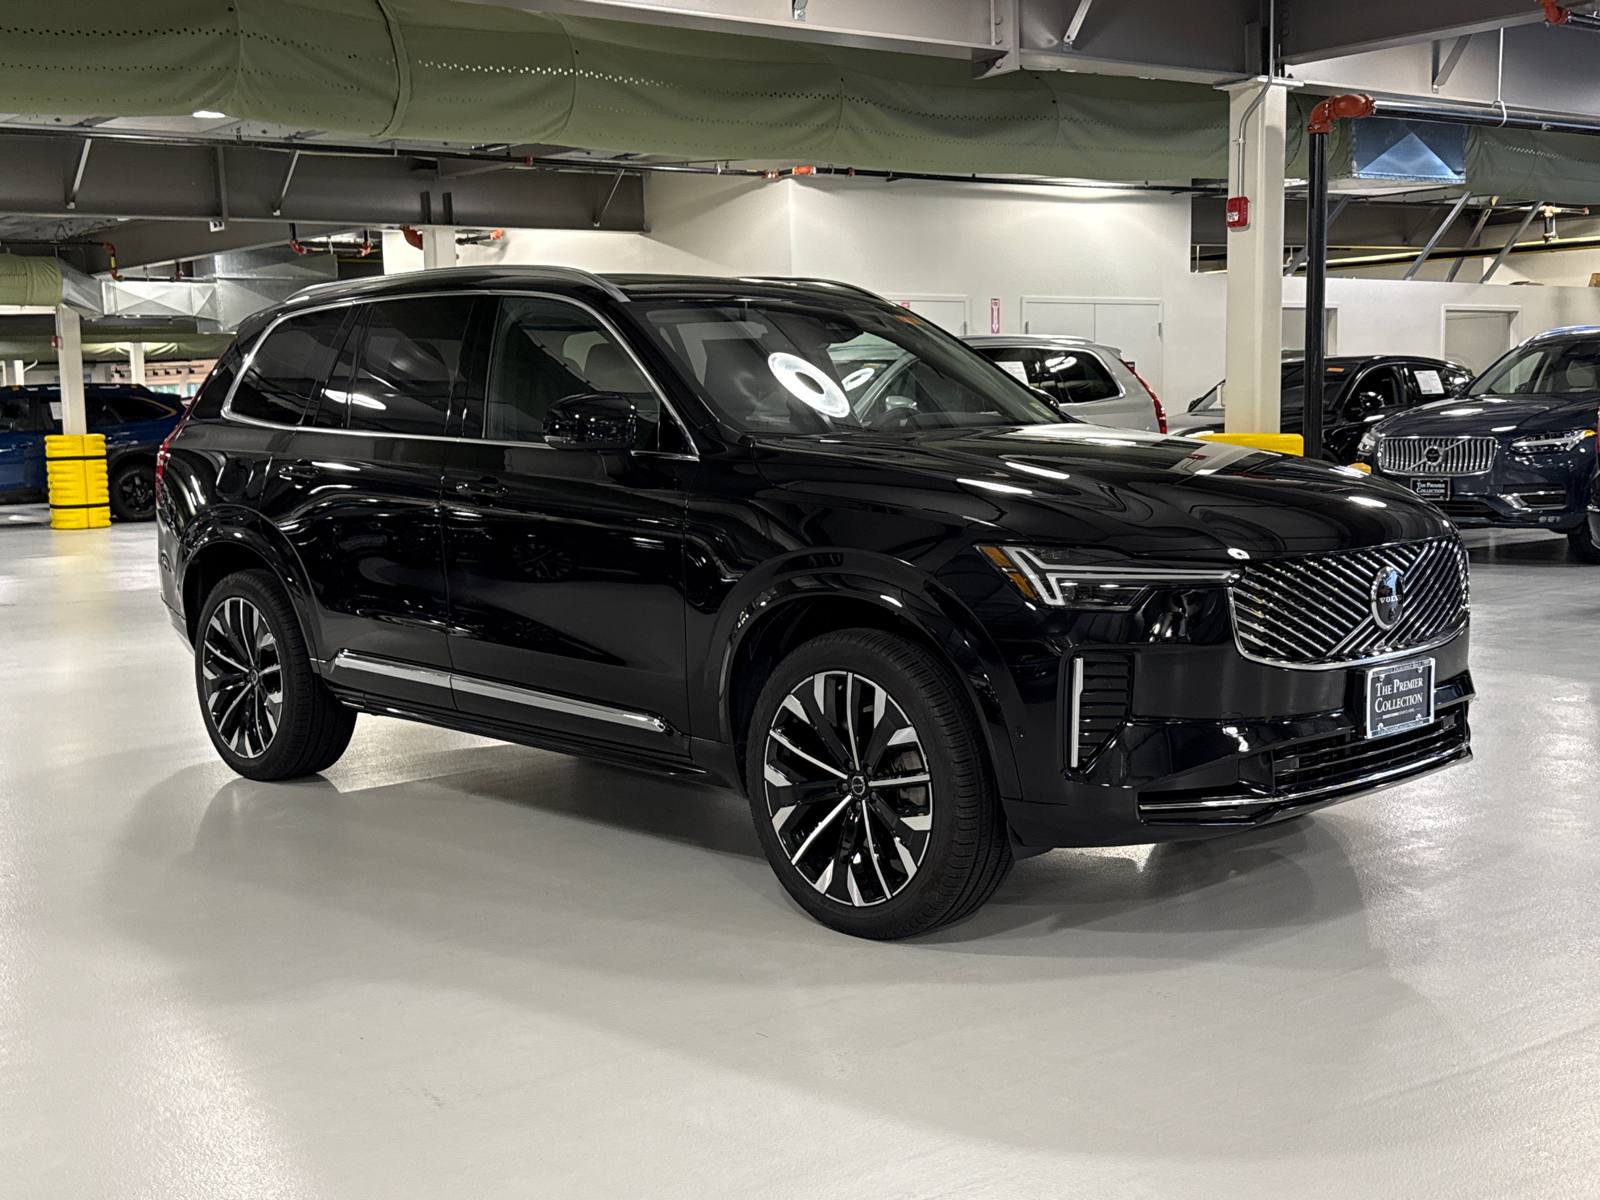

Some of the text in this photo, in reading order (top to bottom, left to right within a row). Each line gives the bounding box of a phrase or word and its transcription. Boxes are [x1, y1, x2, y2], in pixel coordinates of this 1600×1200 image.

[1375, 677, 1424, 697] THE PREMIER
[1375, 693, 1423, 713] COLLECTION
